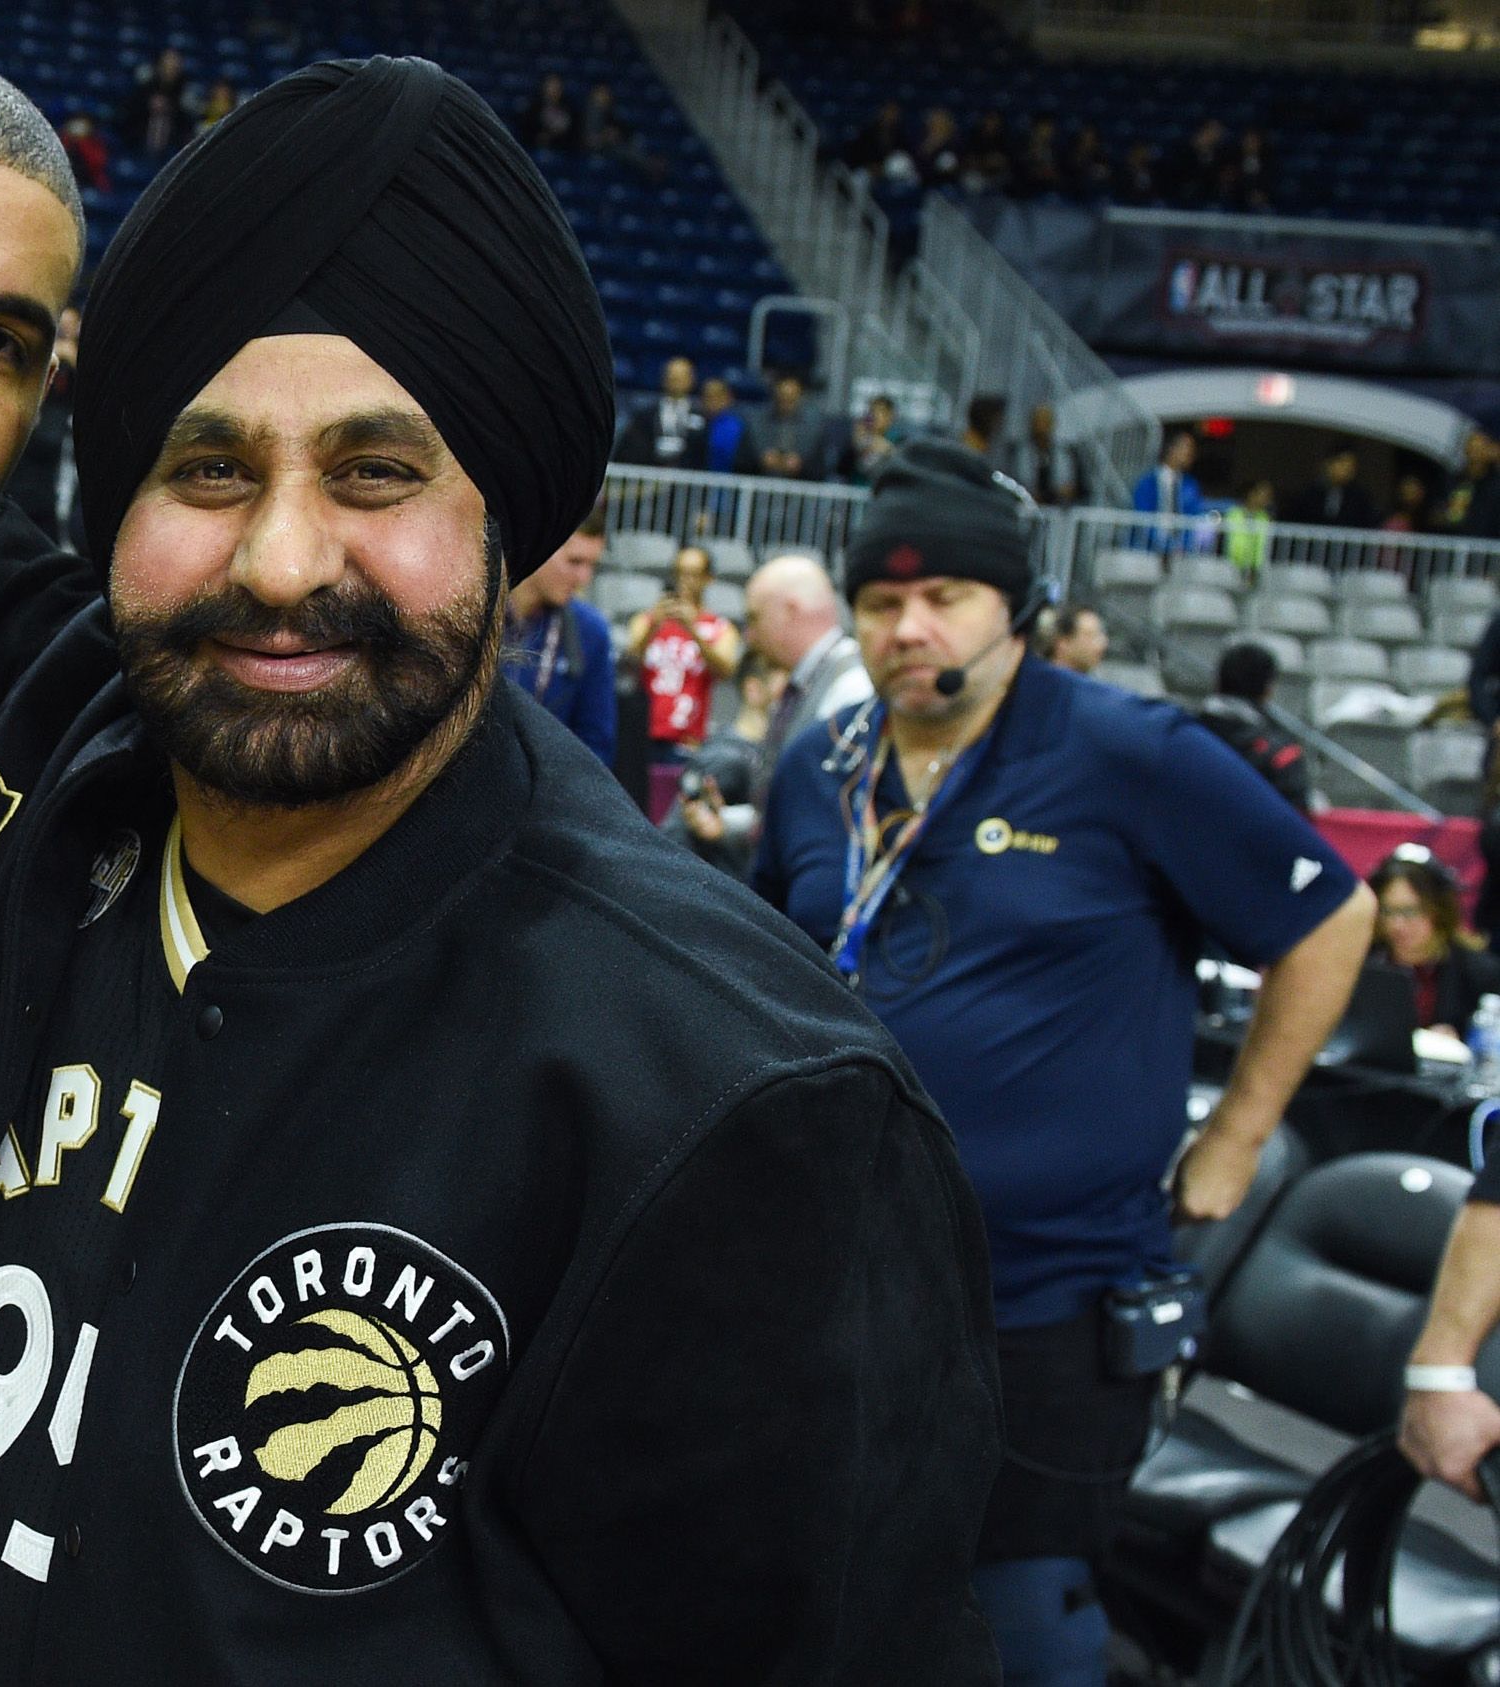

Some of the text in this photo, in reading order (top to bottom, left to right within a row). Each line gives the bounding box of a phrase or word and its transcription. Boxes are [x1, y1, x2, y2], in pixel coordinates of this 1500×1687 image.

[1198, 264, 1276, 317] ALL
[1308, 272, 1419, 331] STAR
[213, 1246, 494, 1381] TORONTO
[193, 1435, 470, 1576] RAPTORS
